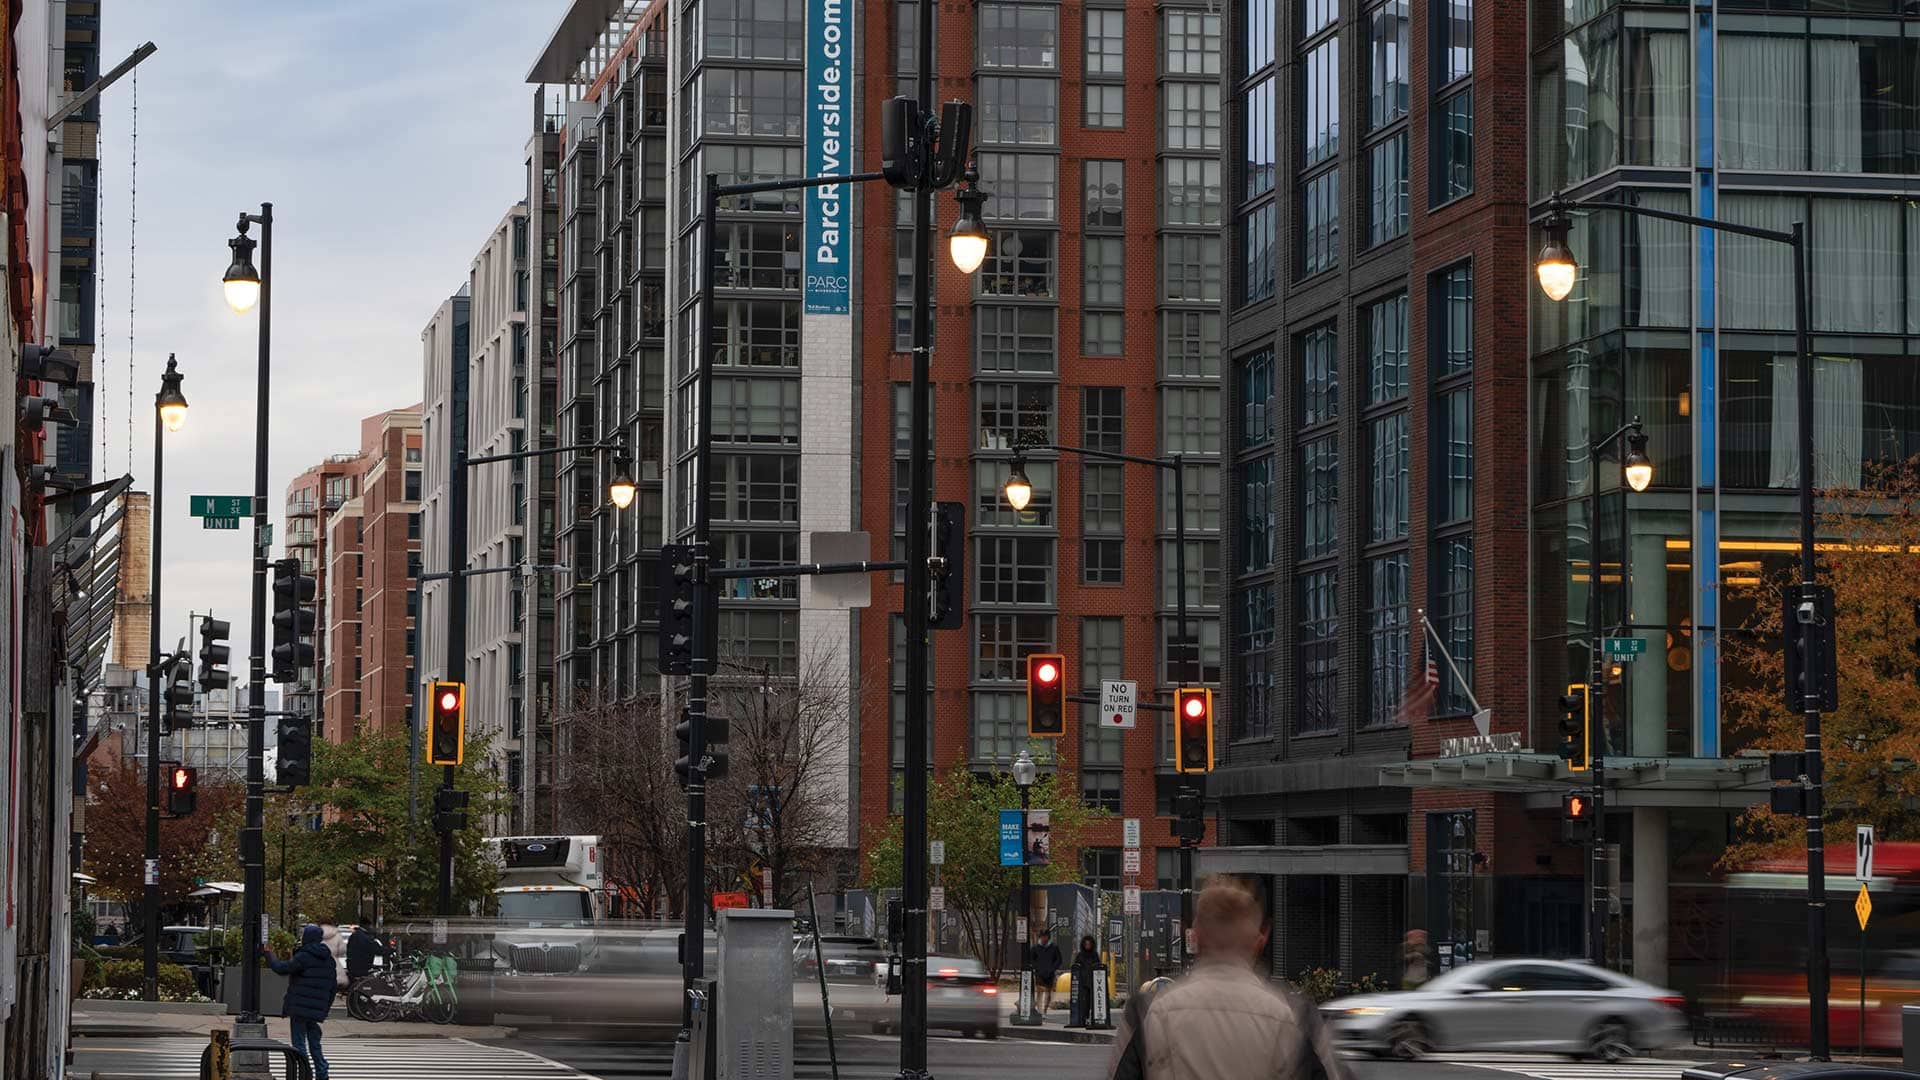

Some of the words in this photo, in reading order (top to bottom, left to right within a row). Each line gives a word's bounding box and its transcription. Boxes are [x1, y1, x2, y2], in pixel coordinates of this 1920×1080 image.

[817, 0, 841, 263] ParcRiverside.com
[807, 275, 848, 289] PARC
[206, 498, 215, 514] M
[231, 498, 241, 507] ST
[205, 518, 235, 529] UNIT
[1613, 640, 1621, 651] M
[1614, 653, 1635, 662] UNIT
[1111, 683, 1128, 694] NO
[1109, 694, 1130, 703] TURN
[1103, 704, 1115, 712] ON
[1117, 704, 1134, 713] RED
